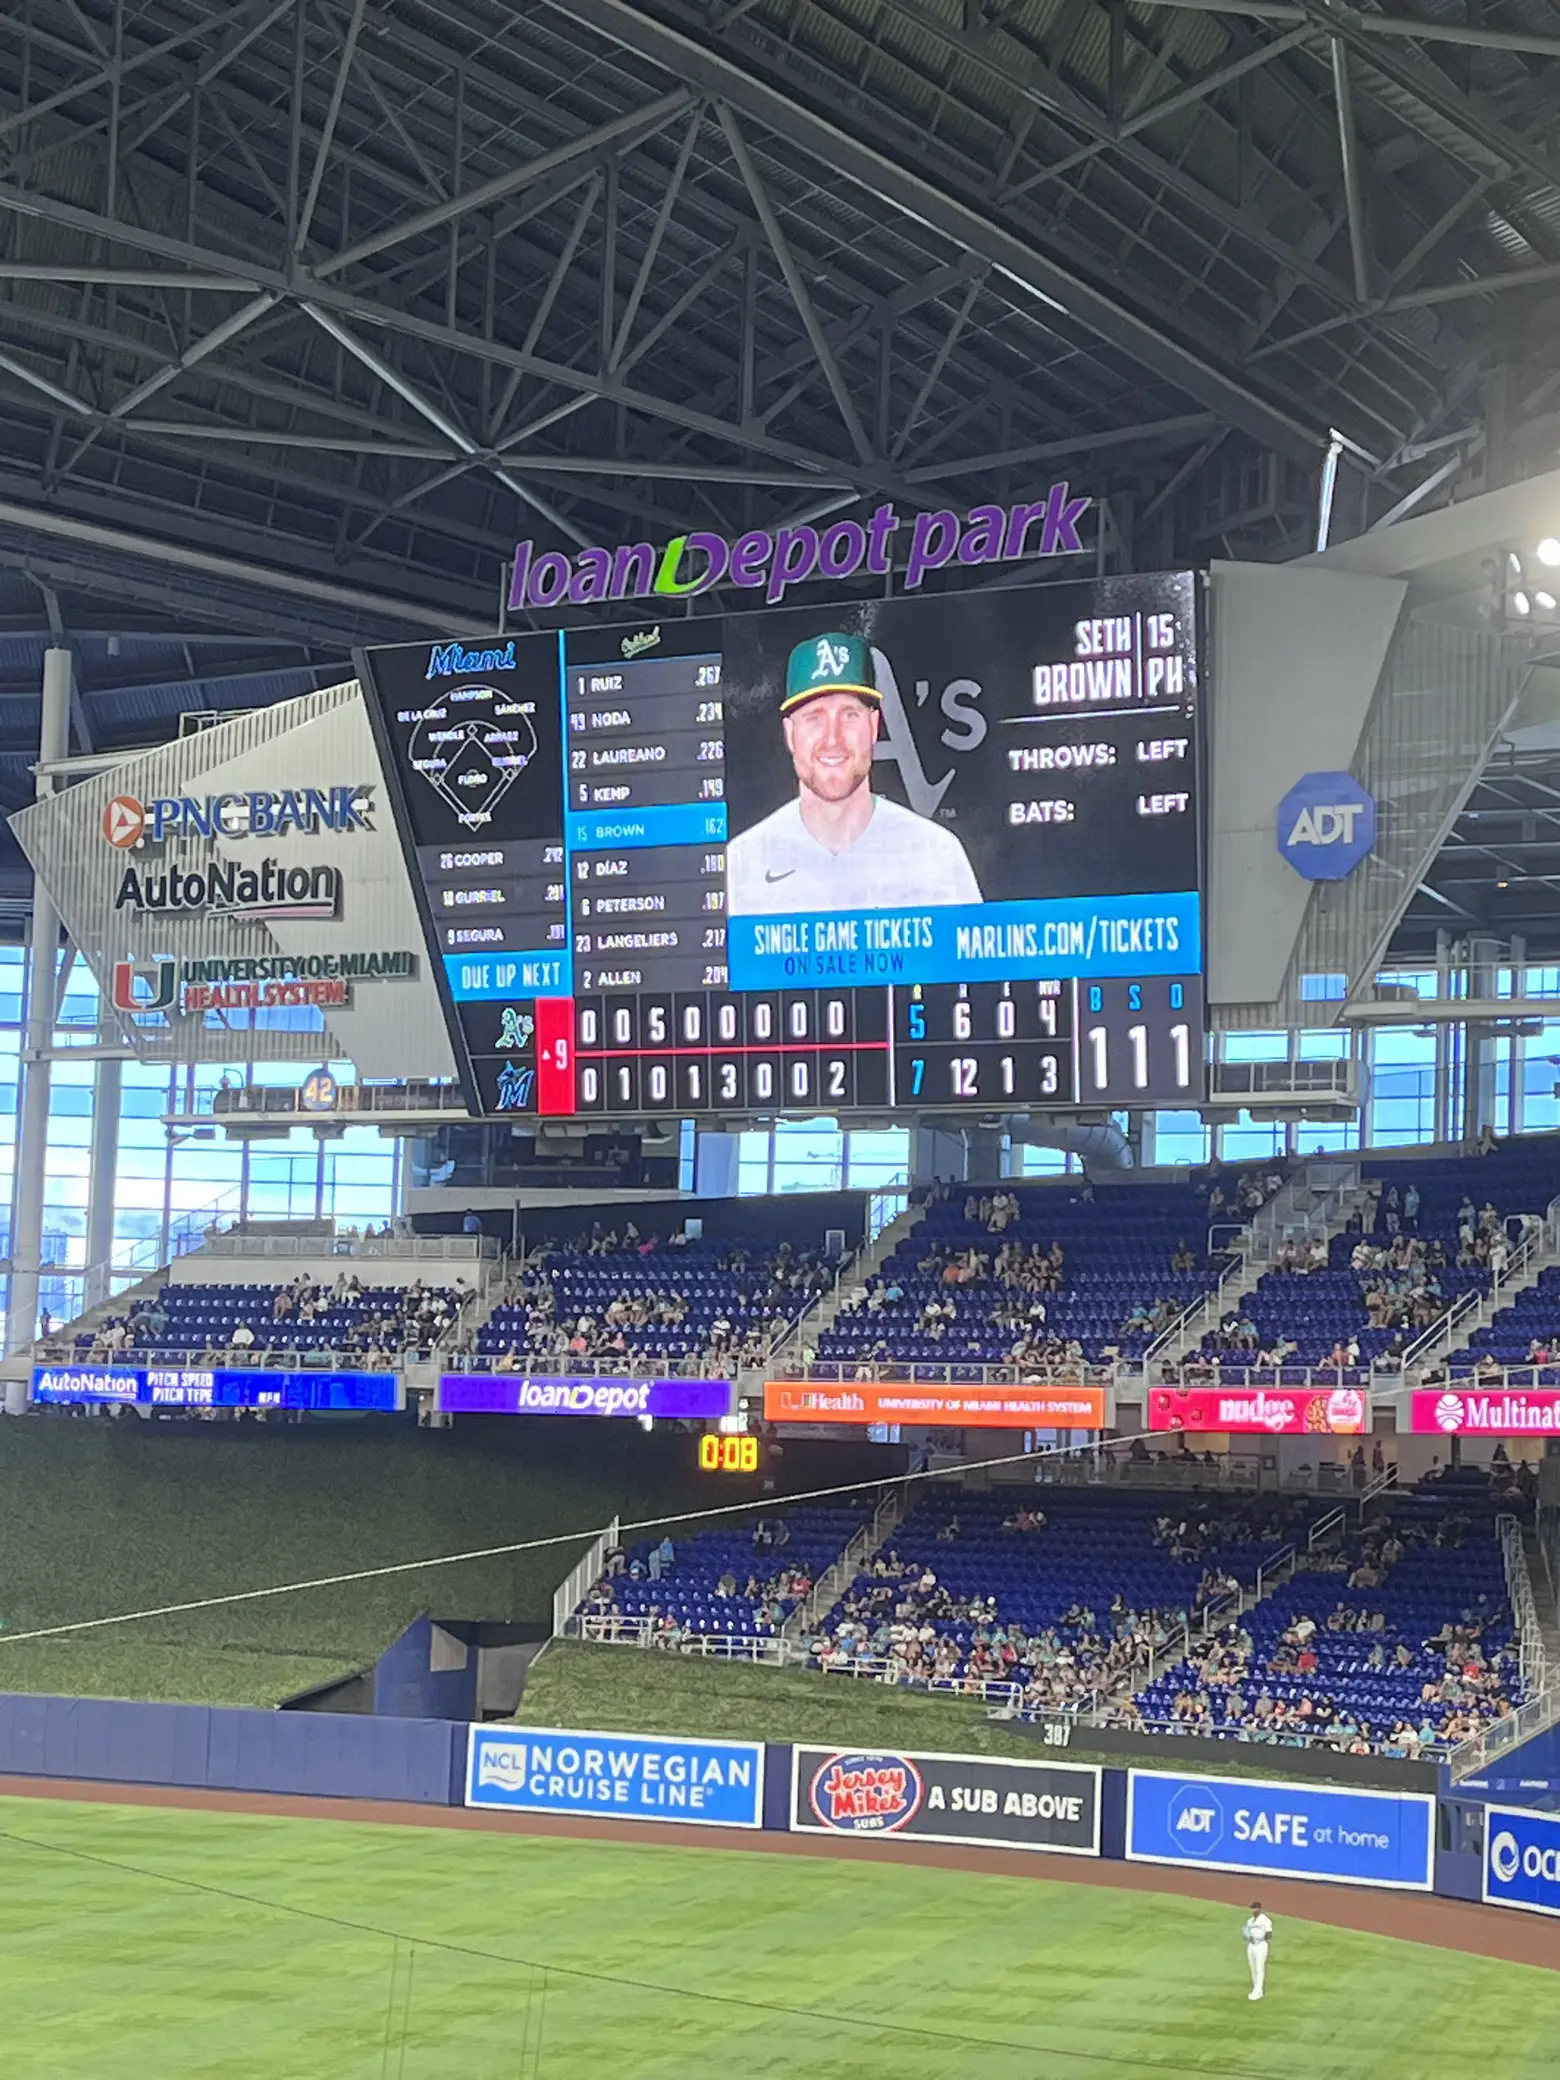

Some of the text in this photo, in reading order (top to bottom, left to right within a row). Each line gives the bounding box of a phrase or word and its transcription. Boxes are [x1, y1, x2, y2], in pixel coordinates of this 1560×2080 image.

[508, 482, 1091, 611] loanDepot park
[1076, 613, 1174, 656] SETH 15
[425, 641, 516, 680] Miami
[811, 639, 850, 680] A's
[578, 677, 585, 695] 1
[591, 676, 623, 692] RUIZ
[1032, 656, 1182, 707] BROWN PH
[591, 711, 631, 727] NODA
[572, 751, 586, 769] 22
[593, 746, 666, 765] LAUREANO
[1009, 739, 1188, 772] THROWS: LEFT
[579, 784, 588, 801] 5
[594, 786, 631, 801] KEMP
[1009, 792, 1189, 825] BATS: LEFT
[577, 826, 587, 841] 15
[596, 824, 645, 839] BROWN
[1287, 804, 1363, 846] ADT
[454, 852, 504, 866] COOPER
[576, 862, 590, 879] 12
[115, 858, 334, 909] AutoNation
[582, 898, 590, 916] 6
[597, 896, 665, 912] PETERSON
[456, 928, 504, 943] SEGURA
[576, 935, 591, 953] 23
[598, 932, 678, 950] LANGELIERS
[754, 916, 933, 955] SINGLE GAME TICKETS
[957, 915, 1178, 960] MARLINS.COM/TICKETS
[183, 956, 302, 982] UNIVERSITY
[338, 951, 411, 977] MIAMI
[461, 962, 561, 989] DUE UP NEXT
[784, 951, 904, 976] ON SALE NOW
[185, 980, 345, 1009] HEALTH SYSTEM
[583, 971, 592, 989] 2
[598, 970, 642, 986] ALLEN
[1090, 983, 1183, 1012] B S O
[581, 1010, 597, 1044] 0
[616, 1008, 631, 1043] 0
[649, 1007, 665, 1042] 5
[685, 1006, 700, 1041] 0
[720, 1005, 736, 1039] 0
[756, 1003, 772, 1038] 0
[792, 1002, 808, 1037] 0
[828, 1001, 844, 1036] 0
[909, 1003, 925, 1039] 5
[954, 1002, 971, 1039] 6
[998, 1001, 1015, 1037] 0
[1040, 999, 1056, 1036] 4
[555, 1039, 568, 1070] 9
[1088, 1024, 1189, 1088] 1 1 1
[306, 1077, 333, 1102] 42
[583, 1068, 598, 1101] 0
[618, 1067, 631, 1100] 1
[651, 1066, 666, 1099] 0
[687, 1065, 700, 1099] 1
[721, 1064, 737, 1099] 3
[757, 1063, 772, 1098] 0
[793, 1062, 808, 1097] 0
[829, 1061, 845, 1096] 2
[911, 1060, 925, 1095] 7
[950, 1058, 977, 1095] 12
[1001, 1056, 1013, 1094] 1
[1041, 1055, 1057, 1093] 3
[38, 1371, 137, 1395] AutoNation
[147, 1372, 214, 1387] PITCH SPEED
[153, 1387, 213, 1403] PITCH TYPE
[518, 1380, 651, 1414] loanDepot
[878, 1397, 943, 1409] UNIVERSITY
[1047, 1401, 1092, 1414] SYSTEM
[1219, 1392, 1294, 1431] nudge
[701, 1434, 758, 1471] 0:08
[483, 1752, 521, 1770] NCL
[531, 1746, 750, 1788] NORWEGIAN
[529, 1775, 705, 1808] CRUISE LINE
[824, 1765, 907, 1794] Jersey
[928, 1786, 1083, 1821] A SUB ABOVE
[853, 1816, 884, 1829] SUBS
[1176, 1807, 1216, 1833] ADT
[1233, 1808, 1390, 1849] SAFE at home
[1523, 1845, 1560, 1883] OC
